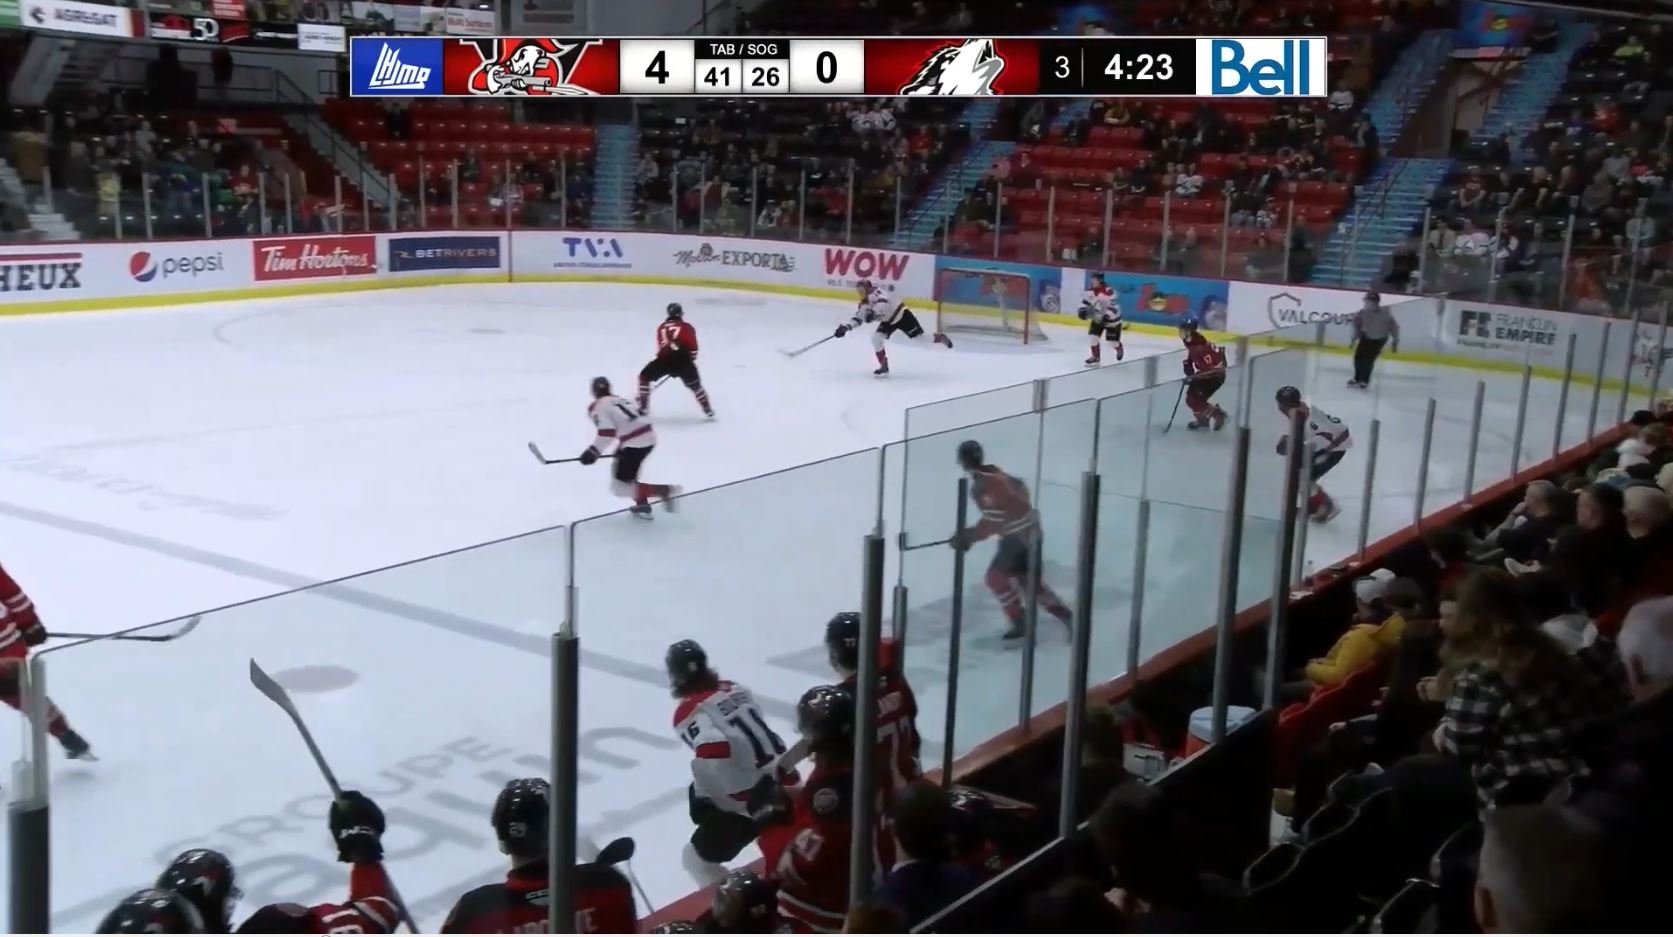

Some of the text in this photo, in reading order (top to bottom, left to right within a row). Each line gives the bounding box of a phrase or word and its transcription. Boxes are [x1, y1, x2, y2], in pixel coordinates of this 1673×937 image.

[261, 243, 369, 272] Tim Hortons
[415, 247, 497, 258] BETRIVERS
[162, 252, 224, 278] pepsi
[825, 247, 910, 281] WOW
[1278, 308, 1354, 326] VALCOUR
[660, 326, 682, 342] 17
[1495, 327, 1557, 346] EMPIRE
